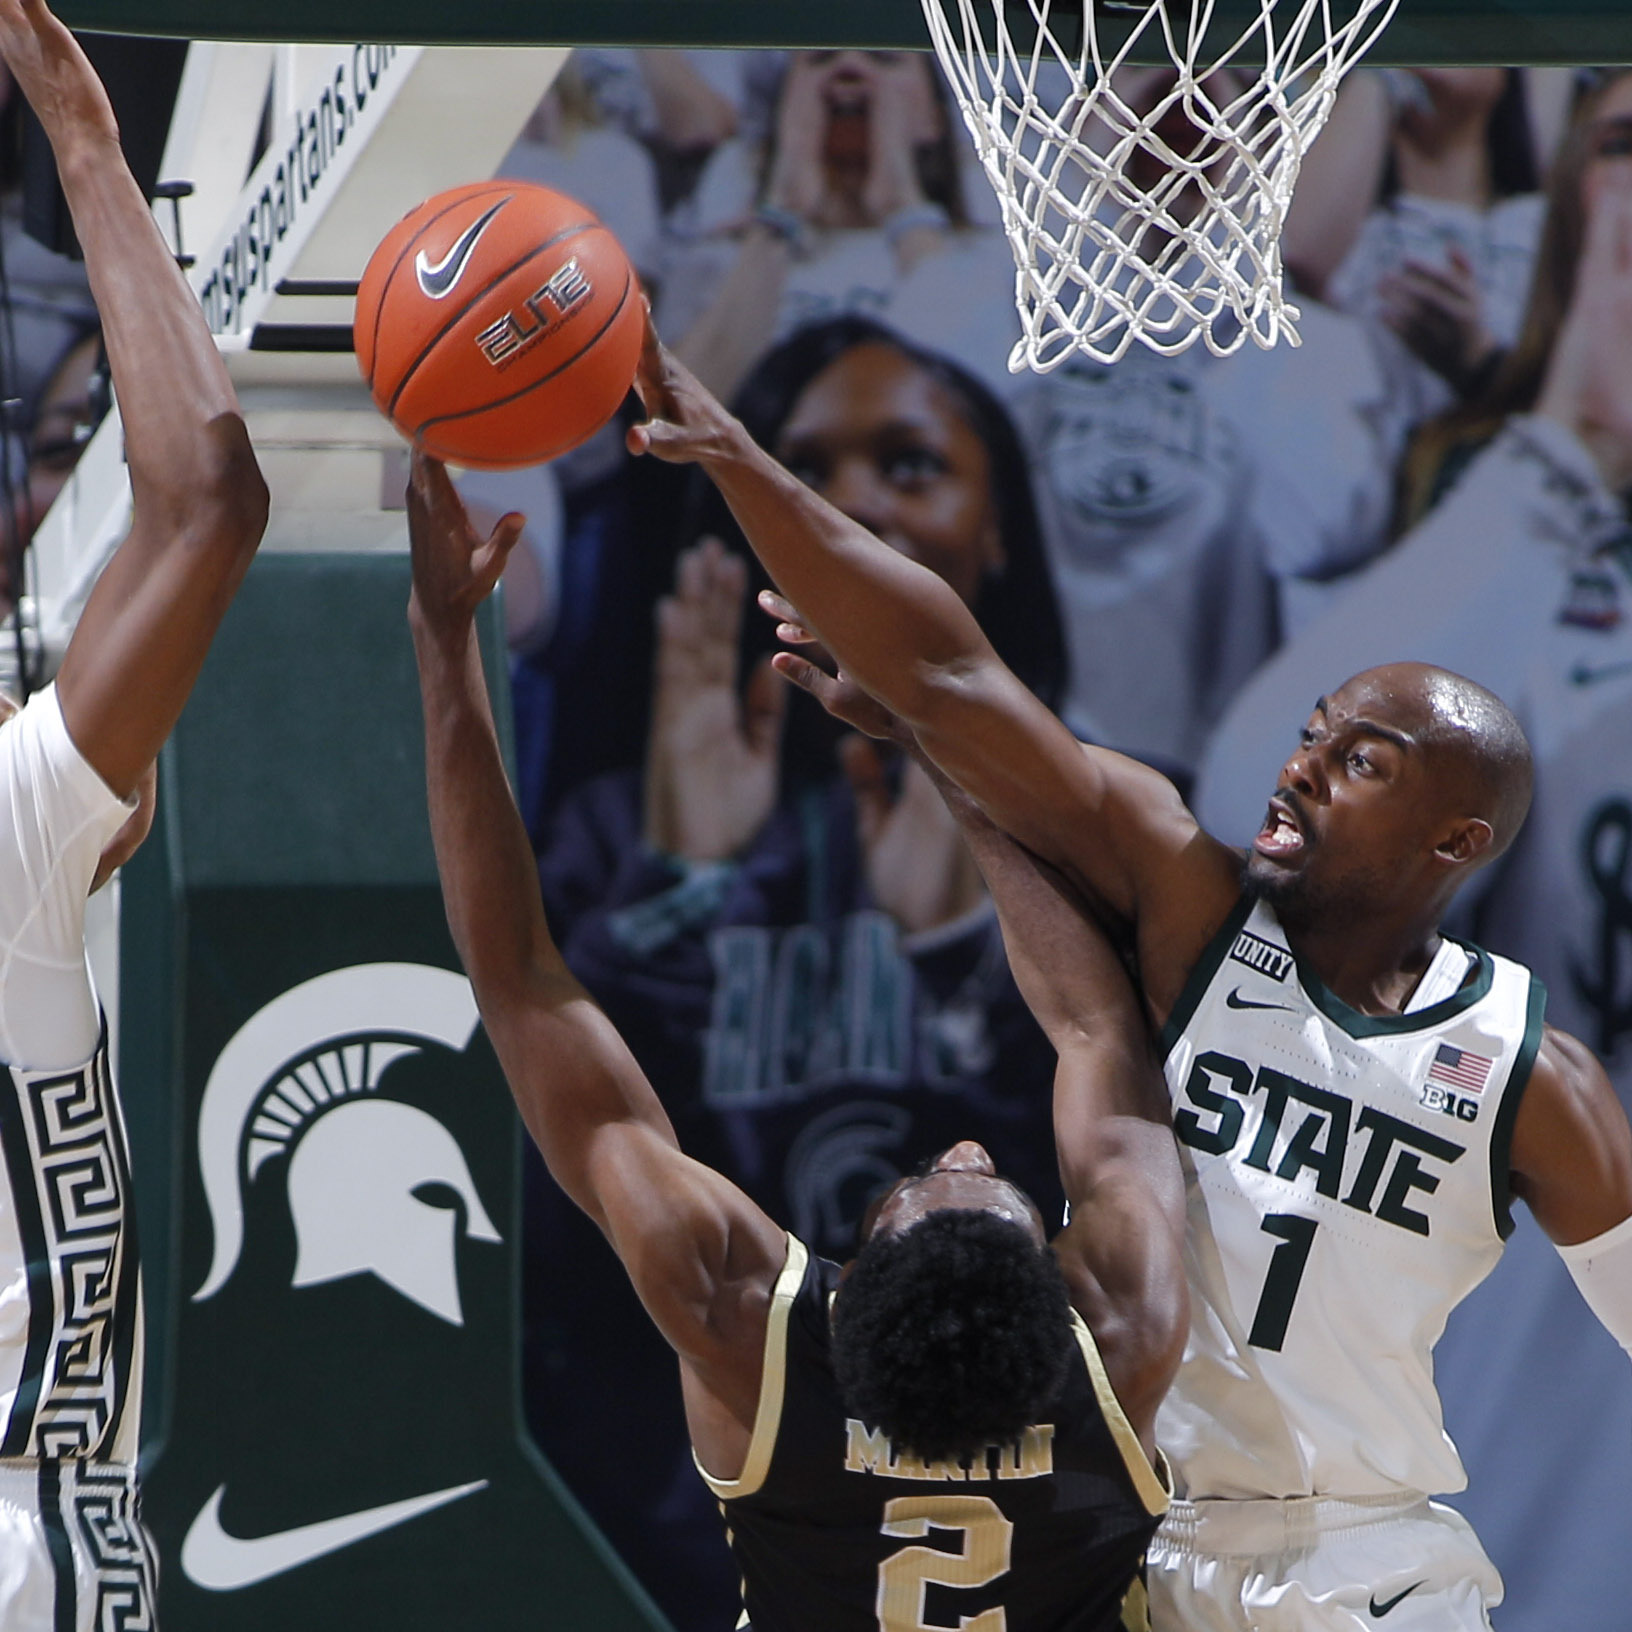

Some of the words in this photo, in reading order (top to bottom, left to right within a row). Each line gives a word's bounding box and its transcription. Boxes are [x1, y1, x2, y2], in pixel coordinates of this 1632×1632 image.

[474, 256, 592, 366] ELITE
[1233, 934, 1294, 979] UNITY
[1174, 1049, 1467, 1237] STATE
[1247, 1212, 1319, 1353] 1
